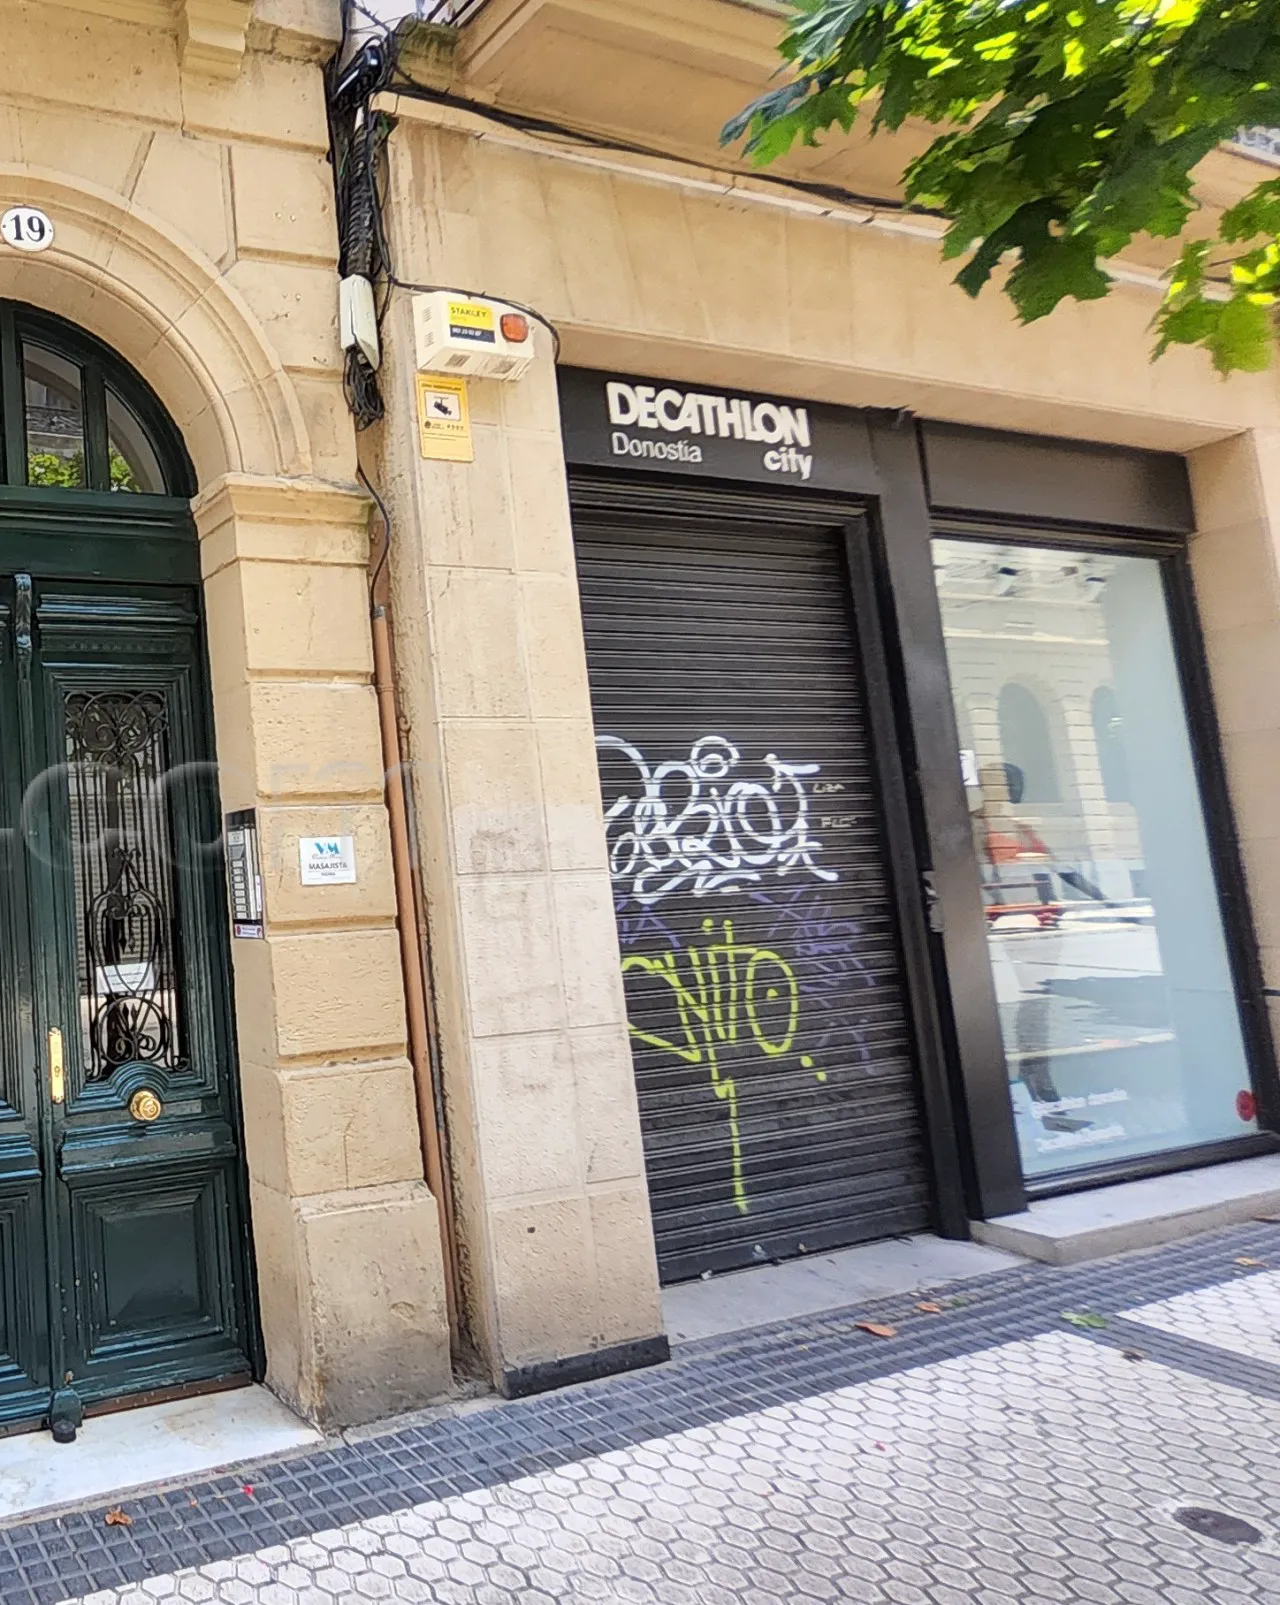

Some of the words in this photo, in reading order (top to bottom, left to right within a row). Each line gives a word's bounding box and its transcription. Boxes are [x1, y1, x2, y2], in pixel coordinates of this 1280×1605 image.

[10, 214, 46, 242] 19
[450, 306, 488, 318] STANLEY
[606, 381, 811, 447] DECATHLON
[763, 446, 813, 481] city
[308, 861, 349, 871] MASAJISTA
